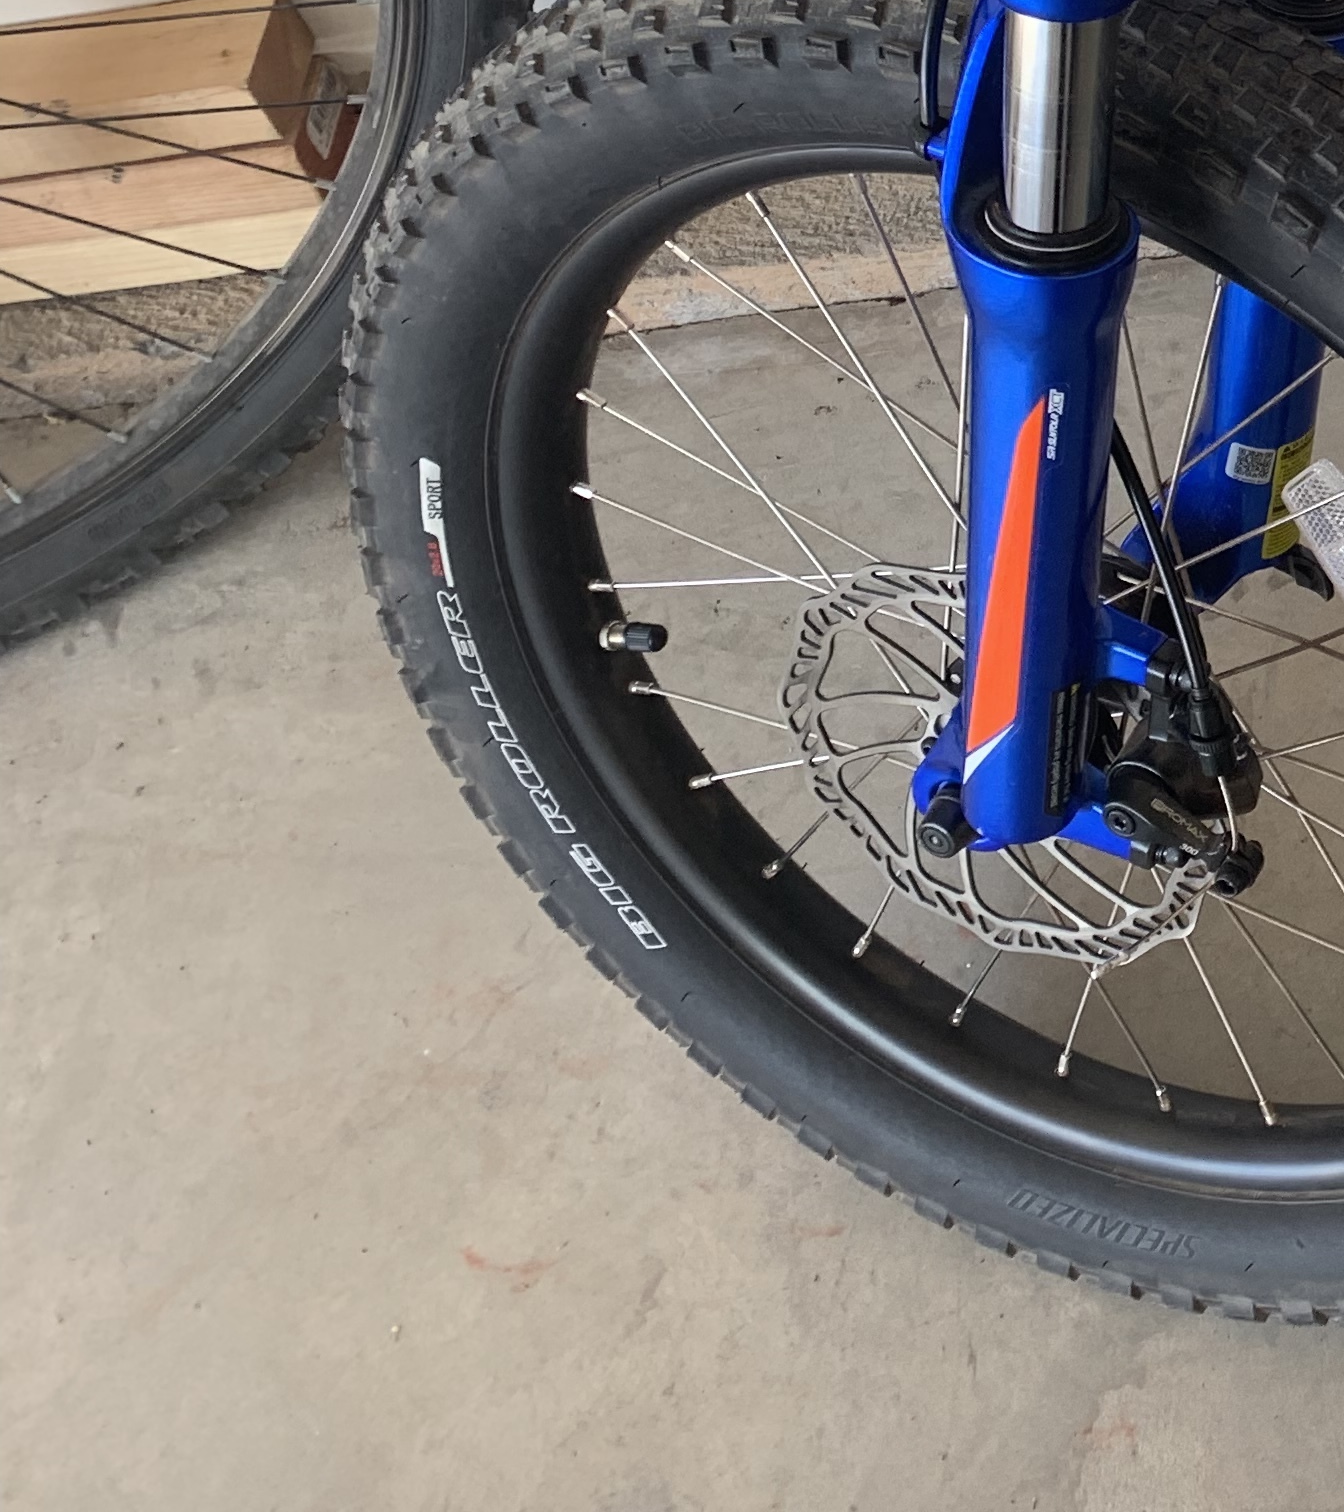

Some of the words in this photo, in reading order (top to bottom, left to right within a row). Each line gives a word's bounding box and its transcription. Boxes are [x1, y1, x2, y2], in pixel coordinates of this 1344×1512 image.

[426, 478, 443, 520] SPORT
[437, 589, 576, 834] ROLLER
[570, 844, 667, 949] BIG
[1006, 1188, 1201, 1259] SPECIALIZED
